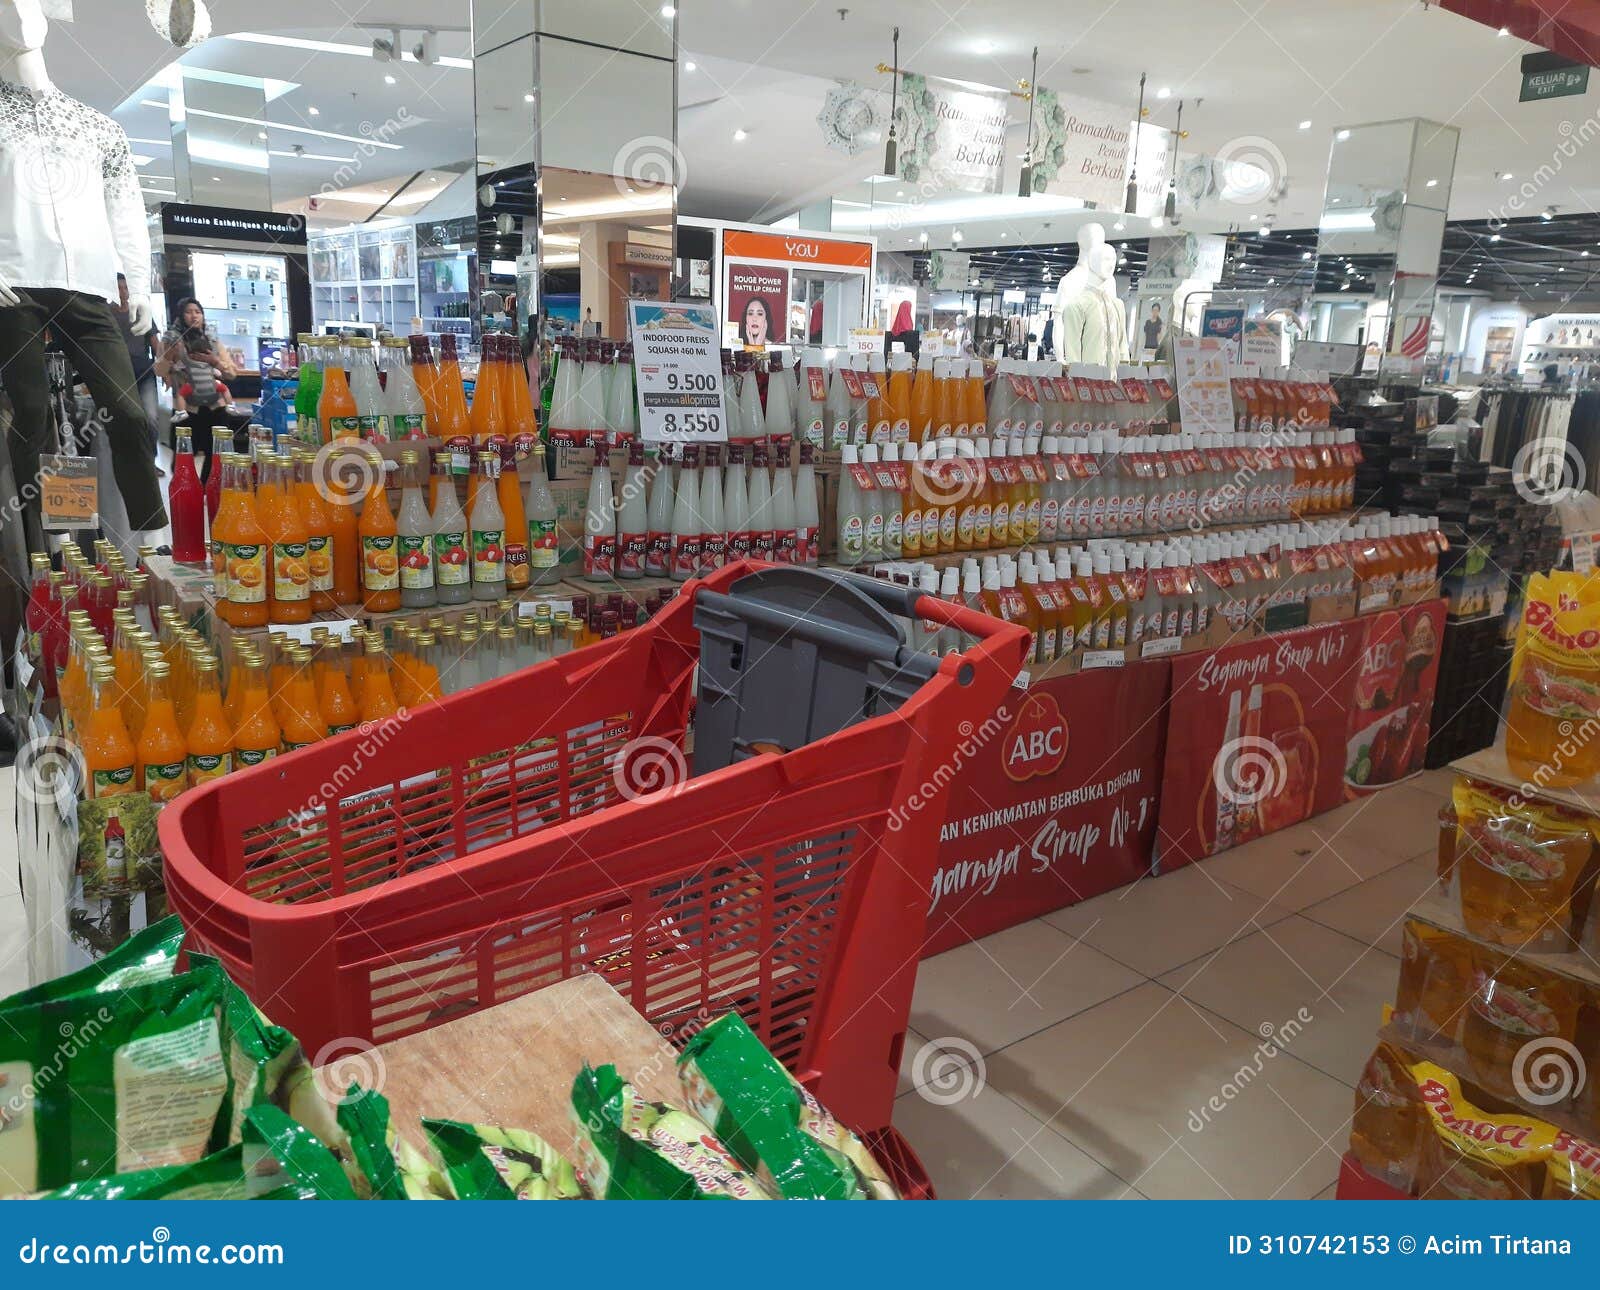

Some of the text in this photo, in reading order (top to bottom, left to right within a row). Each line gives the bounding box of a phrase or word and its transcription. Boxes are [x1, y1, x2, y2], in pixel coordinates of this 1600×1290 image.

[1528, 72, 1566, 88] KELUAR
[1537, 85, 1555, 95] EXIT
[1066, 116, 1128, 143] Ramadhan
[956, 144, 1005, 167] Berkah
[1097, 143, 1126, 160] Penuh
[1080, 158, 1124, 181] Berkah
[733, 275, 782, 286] ROUGE POWER
[733, 284, 752, 292] MATTE
[762, 285, 781, 294] CREAM
[643, 334, 710, 344] INDOFOOD FREISS
[647, 346, 680, 354] SQUASH
[680, 347, 695, 355] 460
[667, 373, 717, 391] 9.500
[664, 413, 720, 433] 8.550
[505, 552, 527, 562] REISS
[1198, 653, 1270, 695] Segarnya
[1275, 639, 1313, 676] Sirup
[1008, 726, 1063, 765] ABC
[963, 798, 1047, 835] KENIKMATAN
[1050, 783, 1104, 811] BERBUKA
[1106, 768, 1141, 796] DENGAN
[1031, 819, 1101, 873] Sirup
